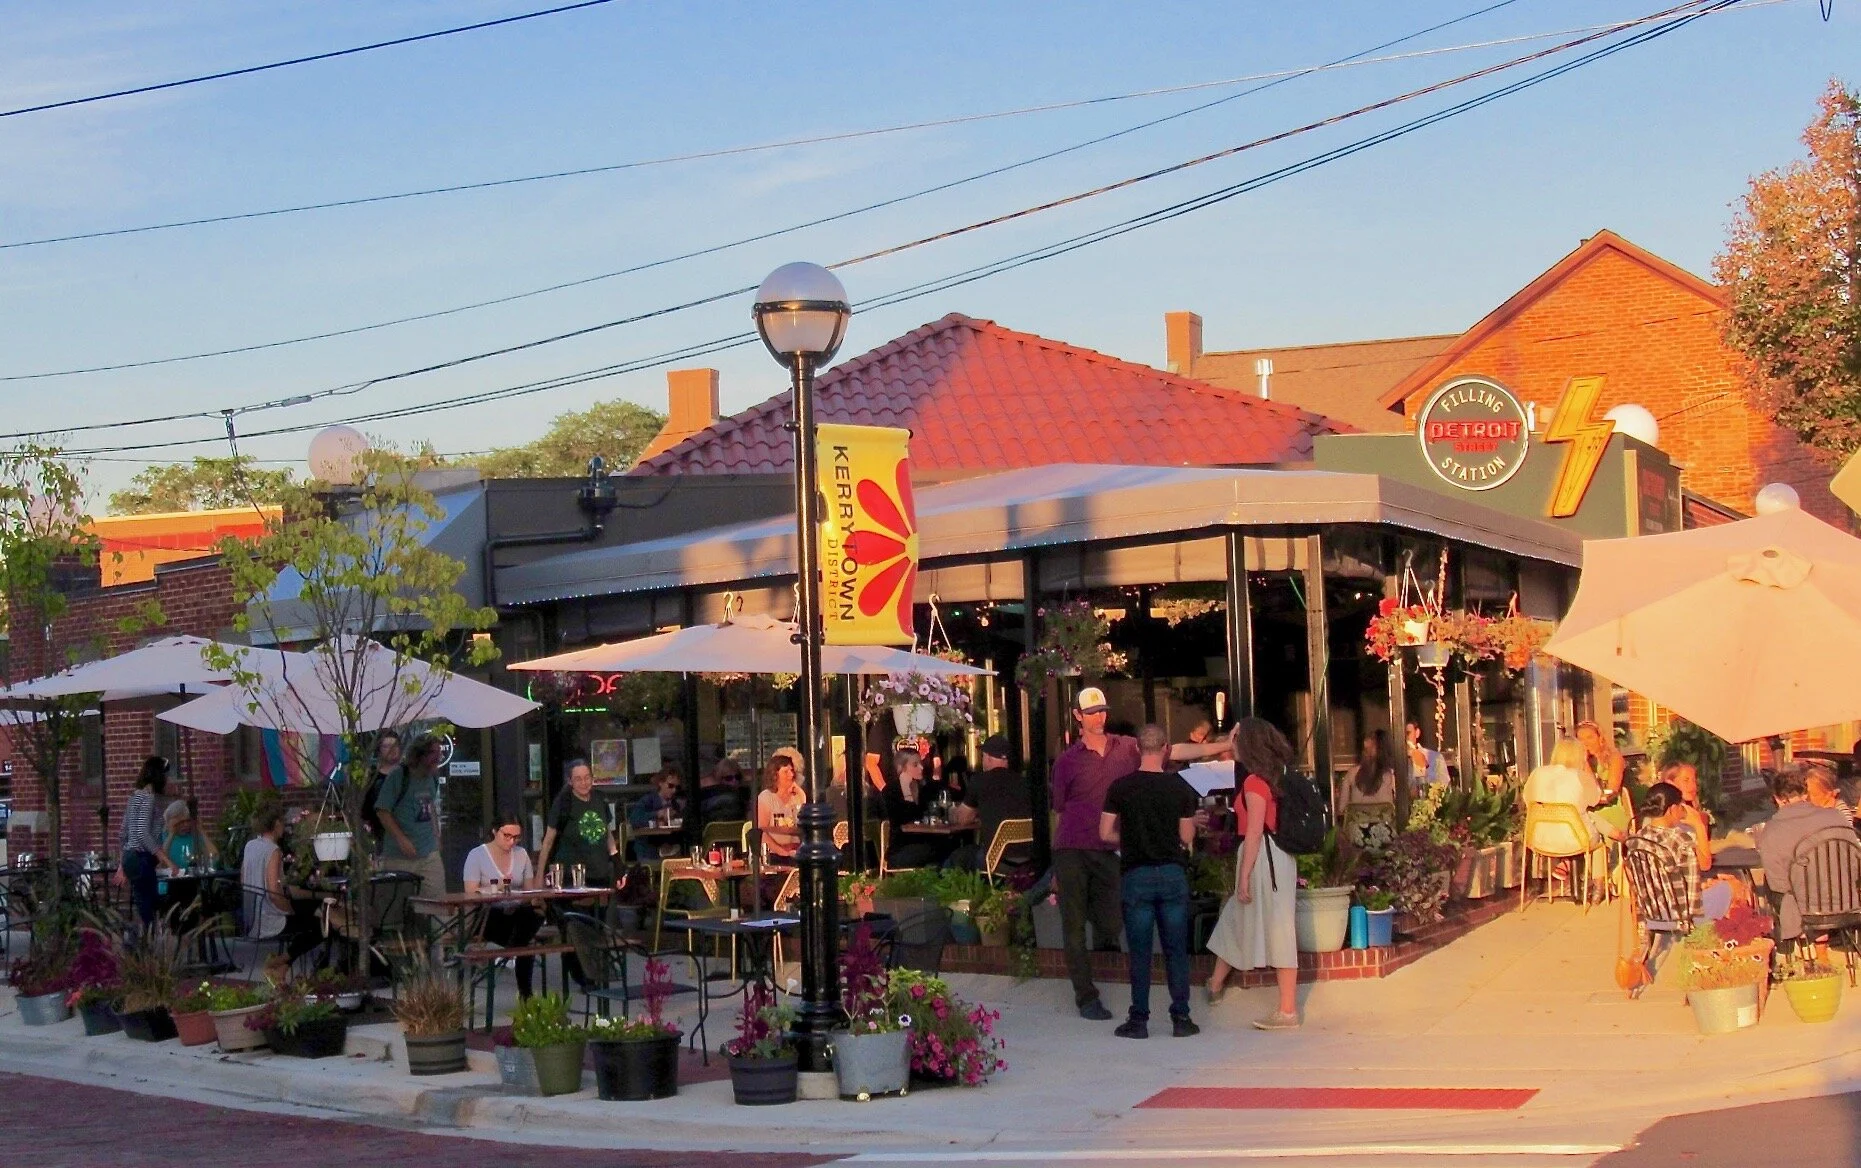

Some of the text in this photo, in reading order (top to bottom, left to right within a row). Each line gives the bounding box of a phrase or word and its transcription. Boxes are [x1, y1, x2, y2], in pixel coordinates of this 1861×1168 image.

[1441, 389, 1503, 413] FILLING
[1432, 422, 1520, 438] DETROIT
[1442, 456, 1506, 480] STATION
[833, 445, 858, 621] KERRYTOWN
[828, 538, 838, 621] DISTRICT
